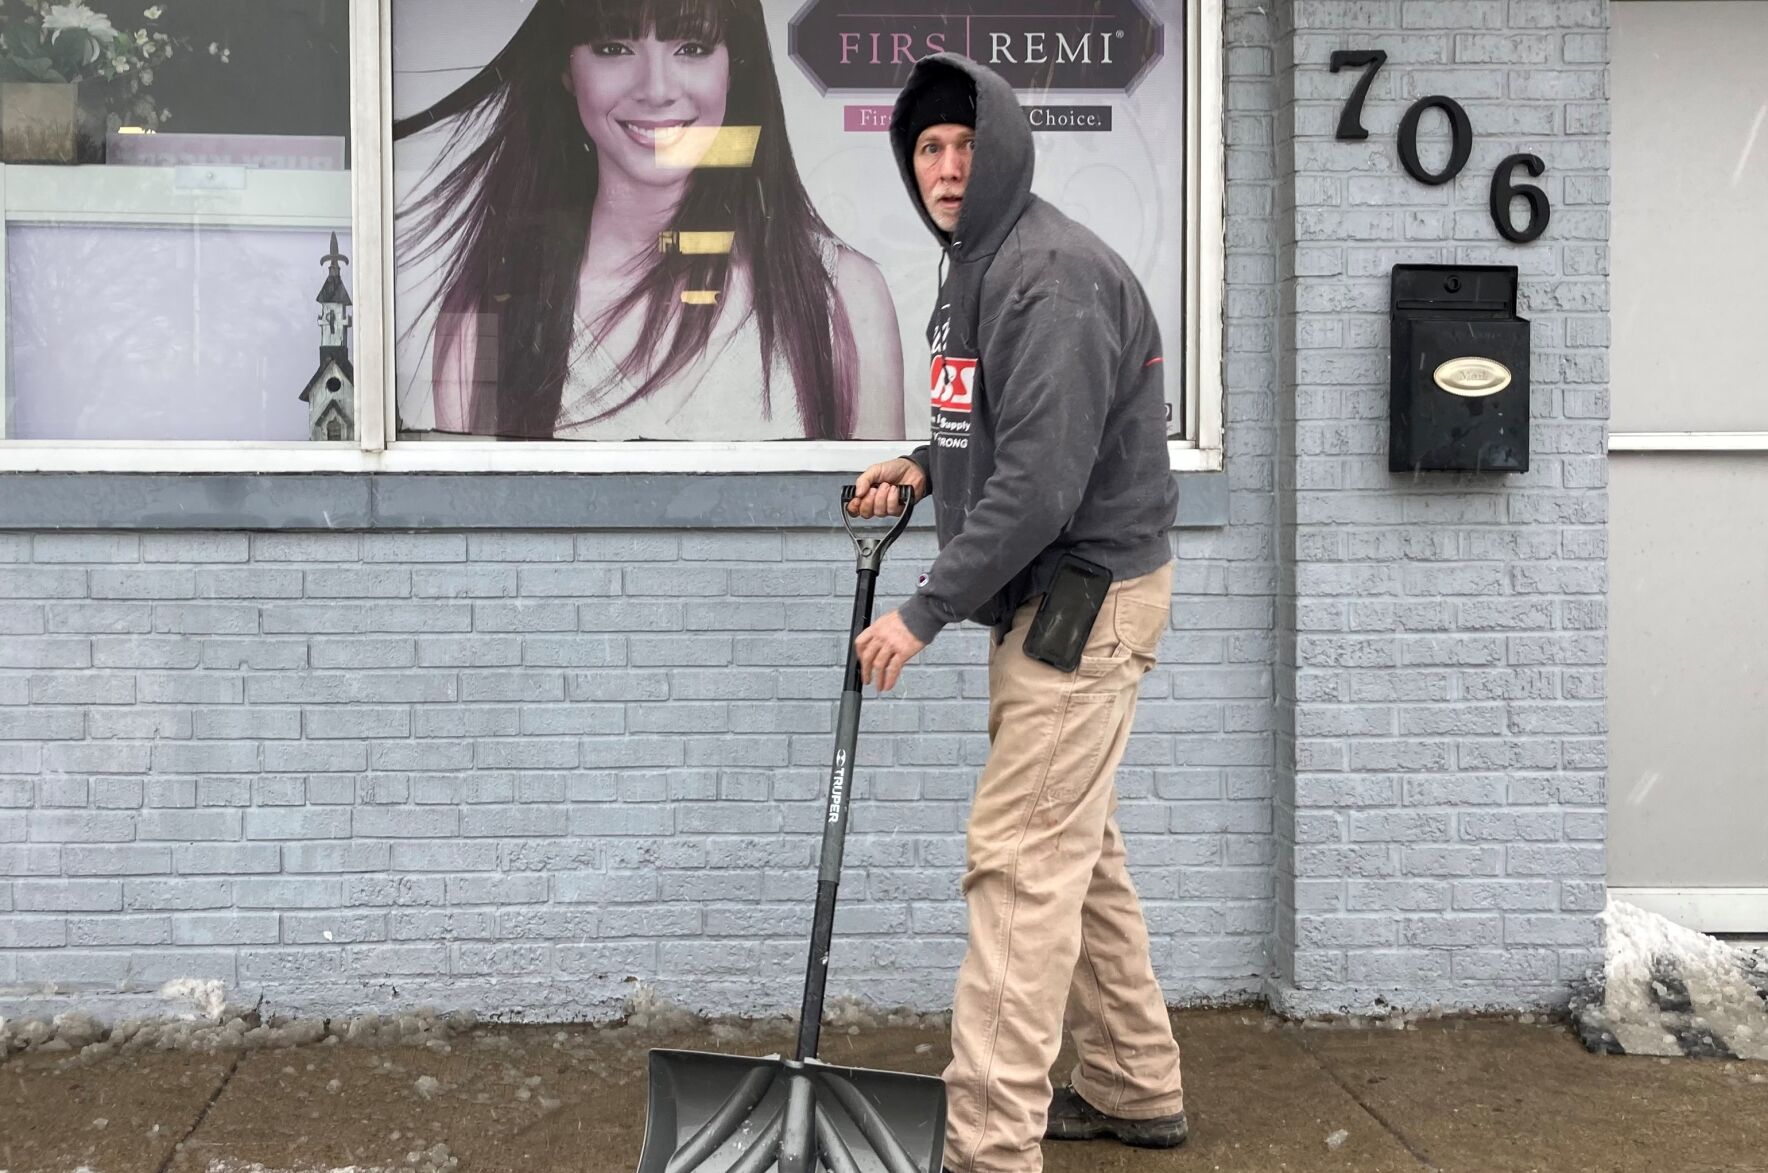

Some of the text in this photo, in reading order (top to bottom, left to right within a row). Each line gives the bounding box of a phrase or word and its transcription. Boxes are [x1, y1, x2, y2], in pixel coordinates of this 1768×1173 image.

[860, 108, 892, 126] Fir
[1029, 108, 1102, 126] Choice.
[1329, 50, 1550, 244] 706
[827, 767, 845, 823] TRUPER
